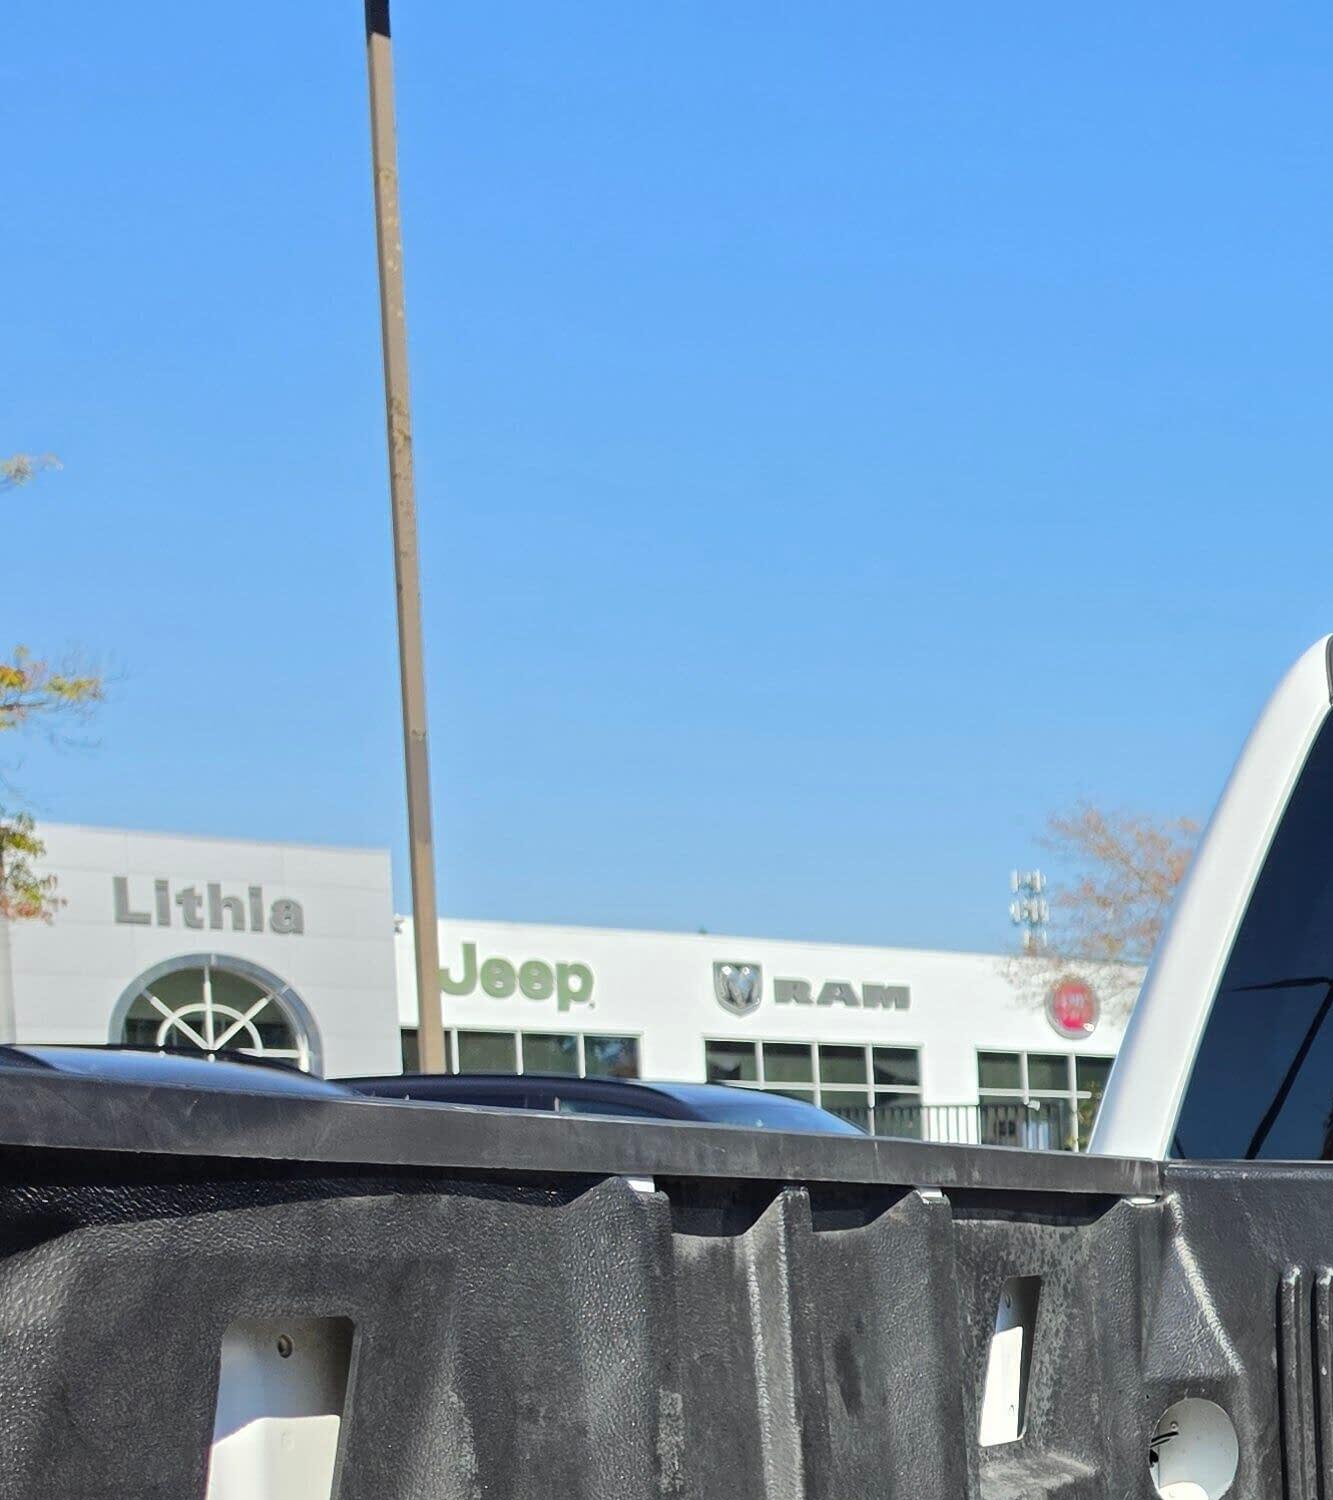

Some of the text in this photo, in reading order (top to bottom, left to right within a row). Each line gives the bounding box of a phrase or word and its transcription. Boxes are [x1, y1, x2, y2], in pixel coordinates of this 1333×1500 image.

[113, 876, 304, 935] Lithia
[438, 943, 589, 1012] Jeep
[773, 977, 911, 1011] RAM
